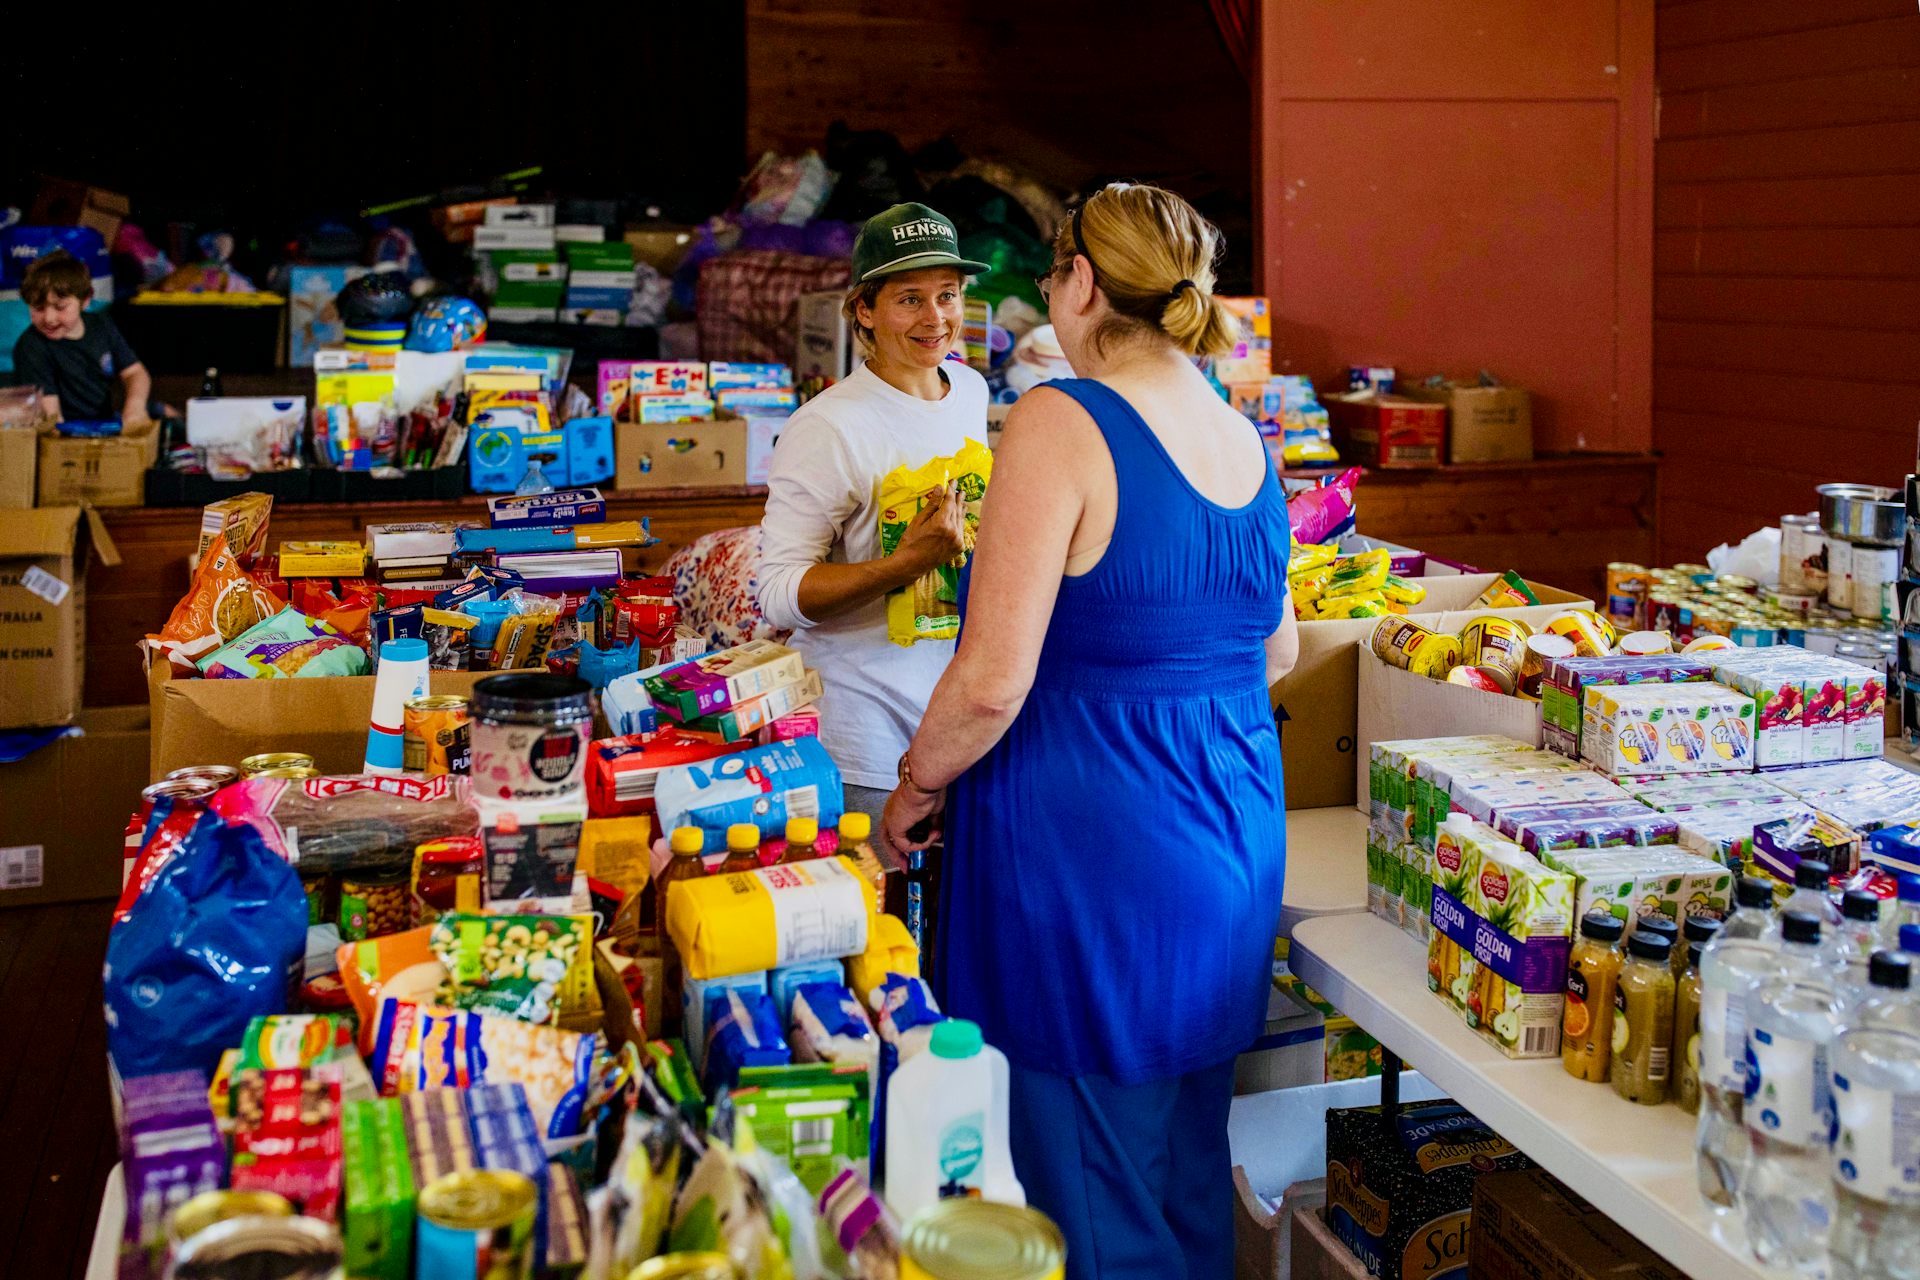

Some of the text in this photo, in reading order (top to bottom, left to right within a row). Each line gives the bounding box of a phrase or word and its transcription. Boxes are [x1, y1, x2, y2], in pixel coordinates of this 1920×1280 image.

[892, 223, 954, 241] HENSON
[1438, 846, 1460, 860] golden
[1441, 856, 1458, 869] circle
[1482, 875, 1508, 889] golden
[1691, 878, 1711, 888] APPLE
[1485, 885, 1505, 898] circle
[1434, 897, 1465, 930] GOLDEN
[1475, 927, 1512, 963] GOLDEN
[1474, 943, 1493, 966] PASH
[1333, 1168, 1382, 1226] Schweppes
